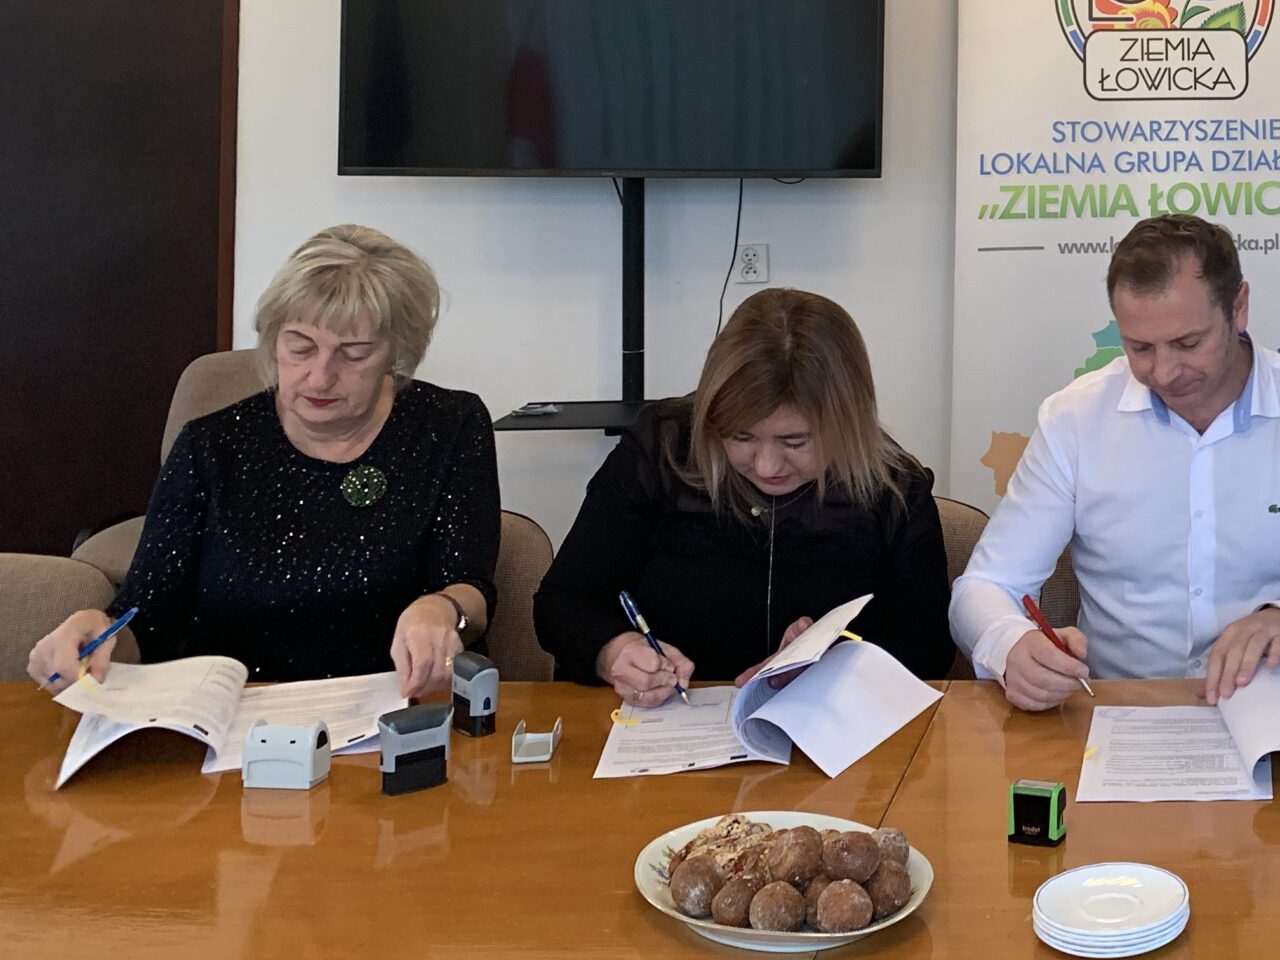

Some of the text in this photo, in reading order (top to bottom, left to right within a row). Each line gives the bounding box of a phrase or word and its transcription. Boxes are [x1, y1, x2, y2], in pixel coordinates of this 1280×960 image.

[1119, 37, 1215, 62] ZIEMIA
[1098, 66, 1236, 92] ŁOWICKA
[979, 152, 1106, 176] LOKALNA
[1114, 150, 1204, 175] GRUPA
[978, 183, 1138, 220] „ZIEMIA
